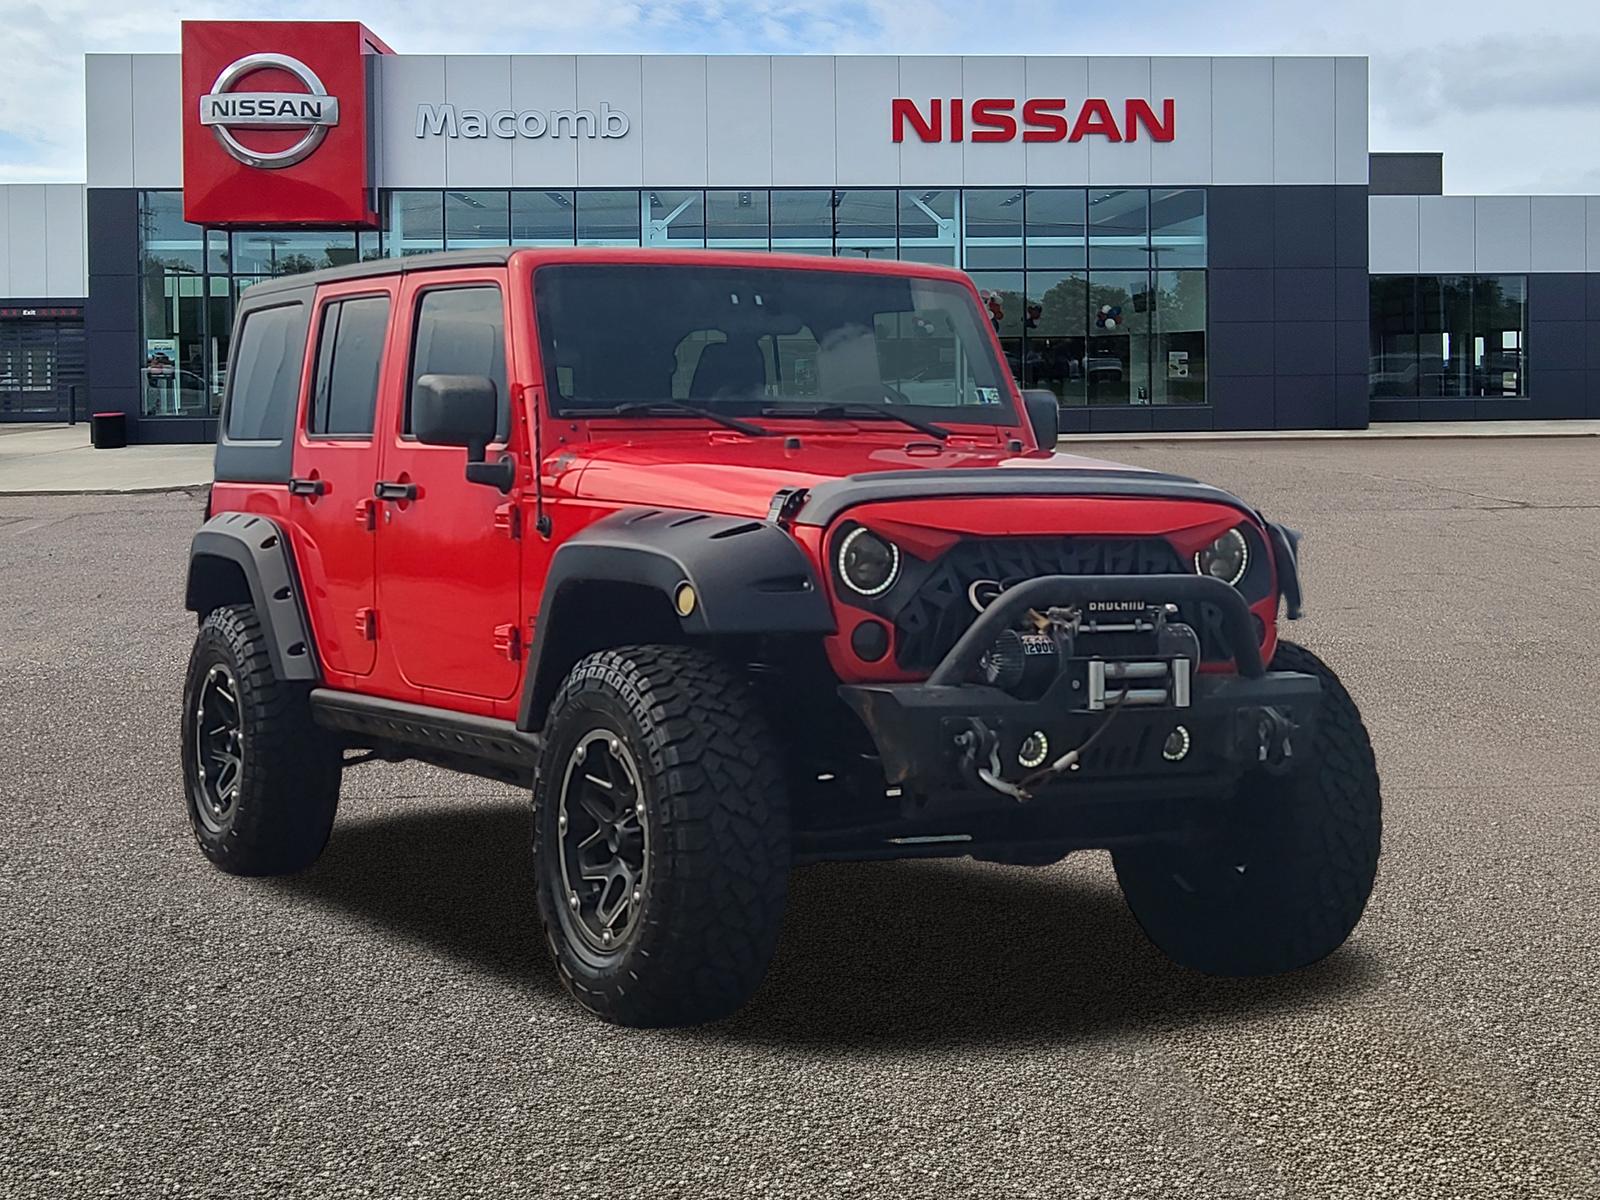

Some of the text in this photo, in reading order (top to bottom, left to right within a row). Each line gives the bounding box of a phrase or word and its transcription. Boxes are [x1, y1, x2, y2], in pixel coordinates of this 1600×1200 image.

[211, 99, 322, 118] NISSAN
[415, 102, 630, 139] Macomb
[891, 97, 1175, 143] NISSAN
